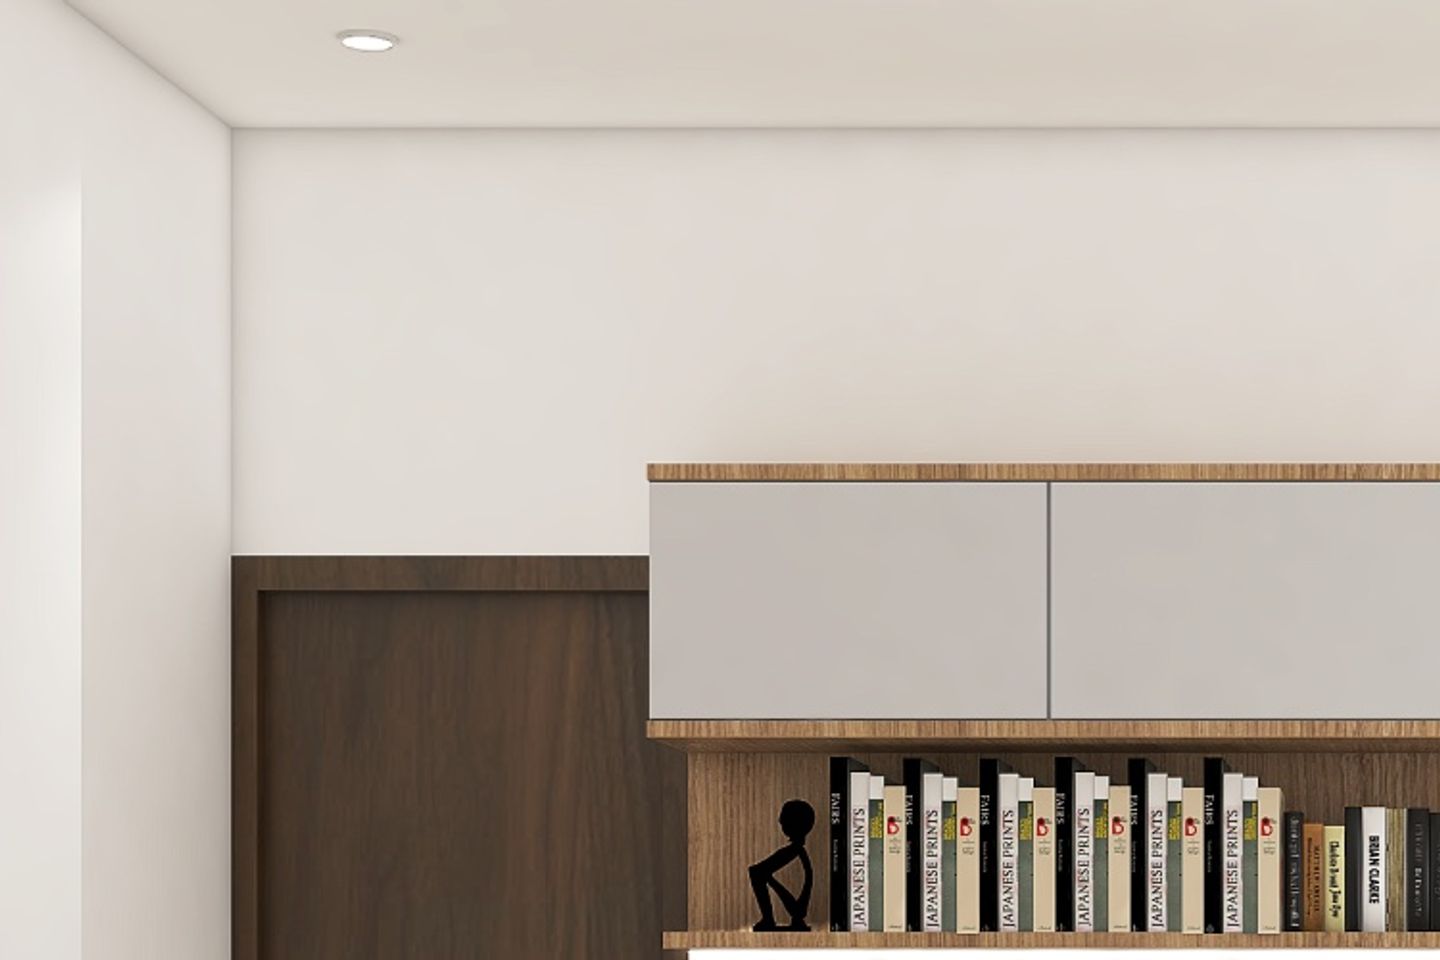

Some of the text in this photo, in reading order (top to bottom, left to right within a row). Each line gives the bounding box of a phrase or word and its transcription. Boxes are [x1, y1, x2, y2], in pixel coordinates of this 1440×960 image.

[853, 808, 866, 927] JAPANESE PRINTS
[926, 809, 939, 928] JAPANESE PRINTS
[1002, 809, 1015, 928] JAPANESE PRINTS
[1078, 808, 1091, 927] JAPANESE PRINTS
[1151, 809, 1164, 928] JAPANESE PRINTS
[1227, 809, 1240, 928] JAPANESE PRINTS
[1368, 836, 1380, 904] BRIAN CLARKE
